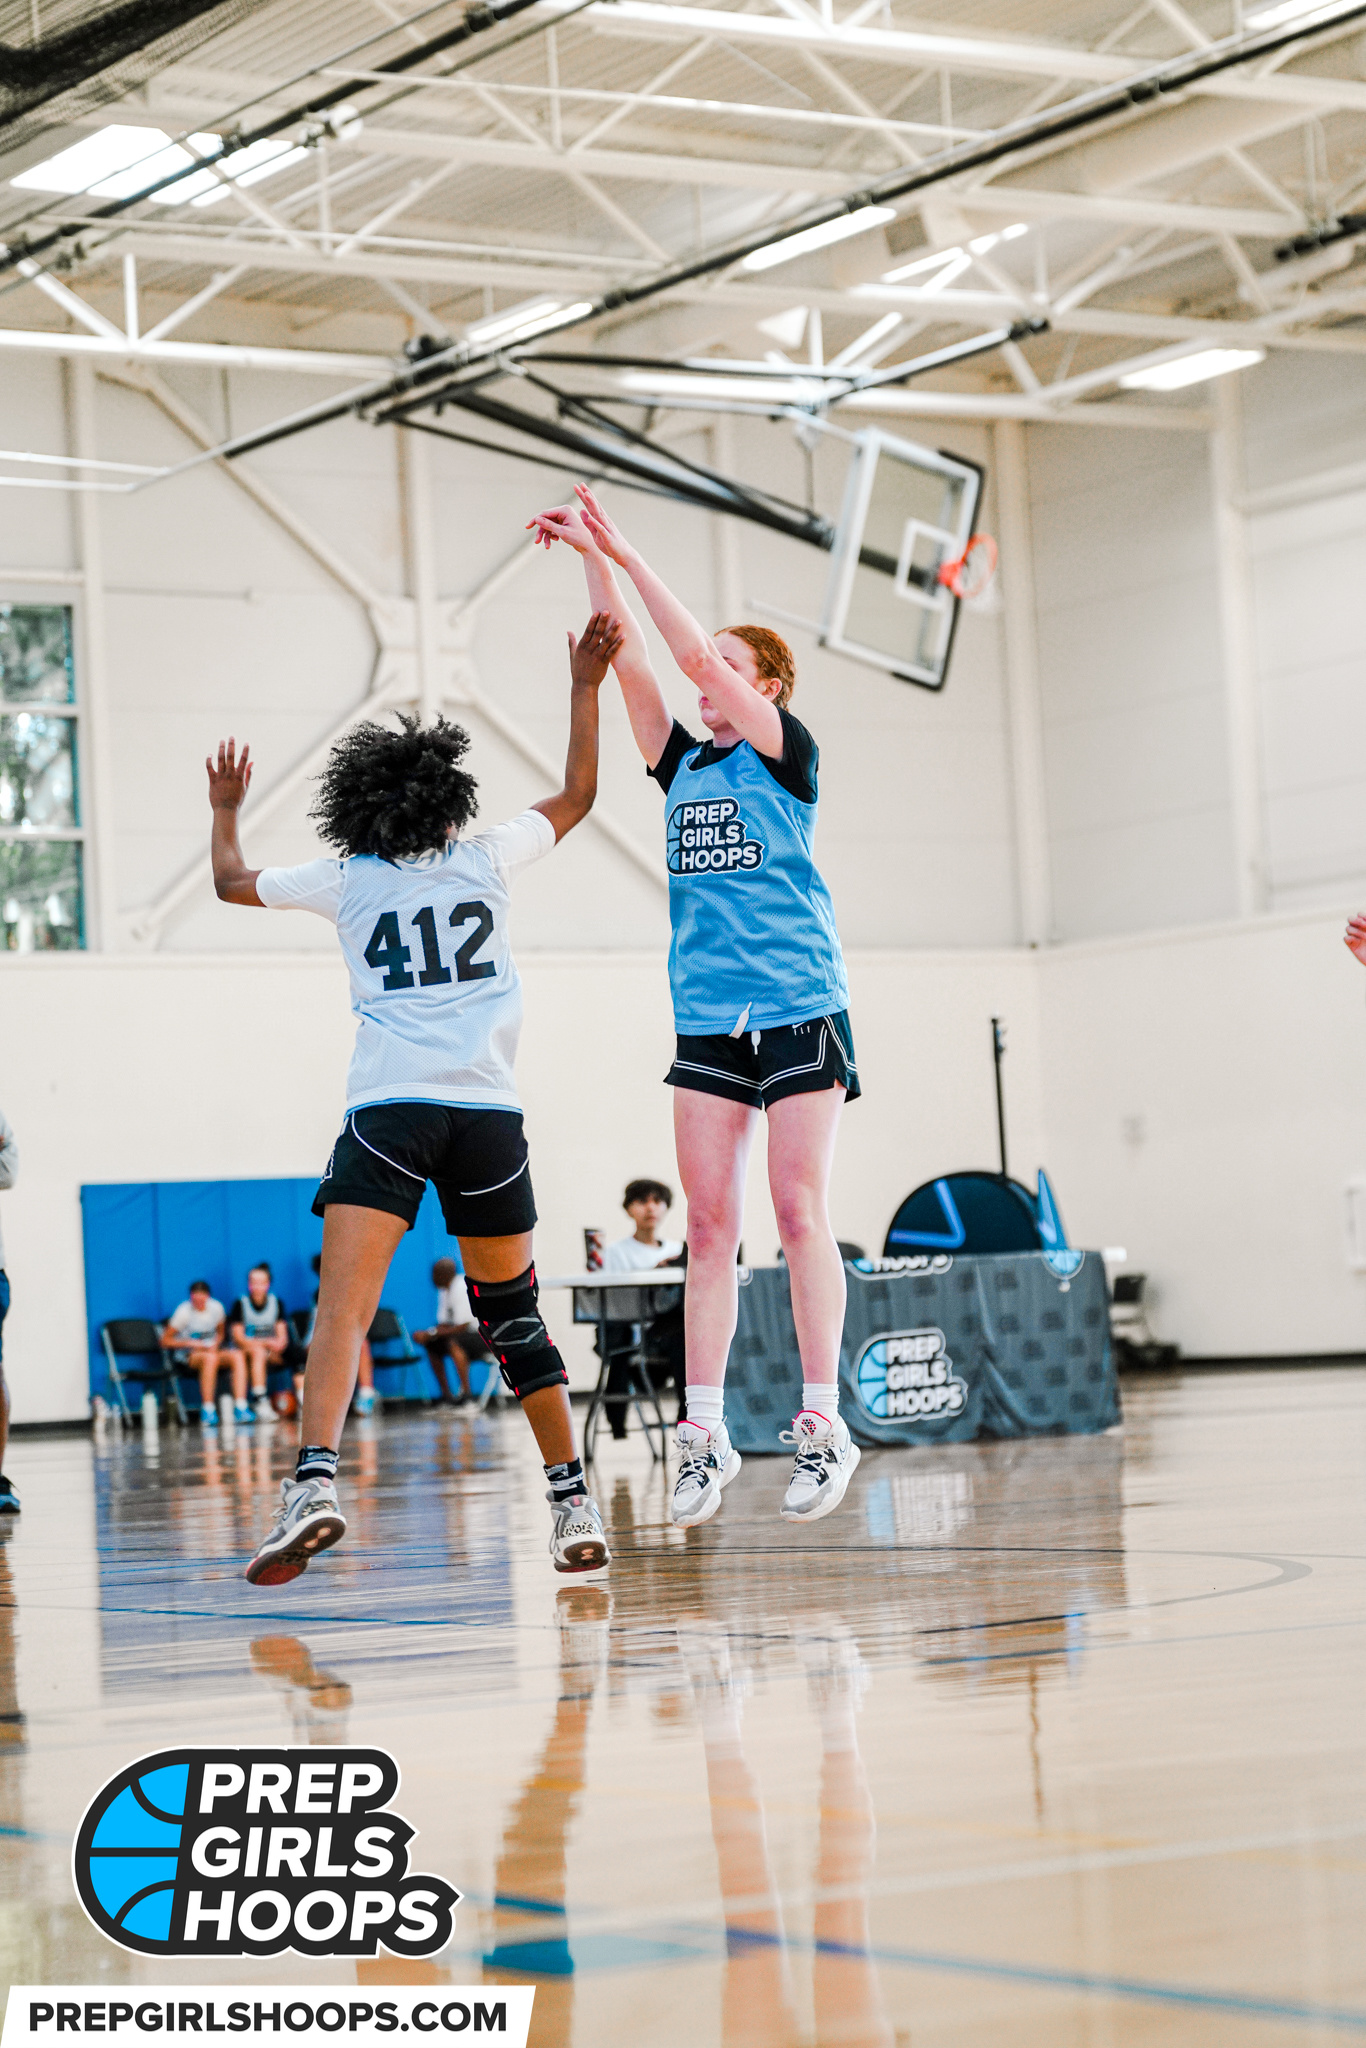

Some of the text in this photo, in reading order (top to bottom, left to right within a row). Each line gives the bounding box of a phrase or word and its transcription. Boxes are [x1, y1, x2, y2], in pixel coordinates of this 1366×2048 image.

[683, 803, 734, 825] PREP
[682, 825, 740, 847] GIRLS
[682, 845, 757, 870] HOOPS
[364, 901, 497, 991] 412
[886, 1335, 941, 1364] PREP
[886, 1359, 947, 1390] GIRLS
[886, 1383, 963, 1416] HOOPS
